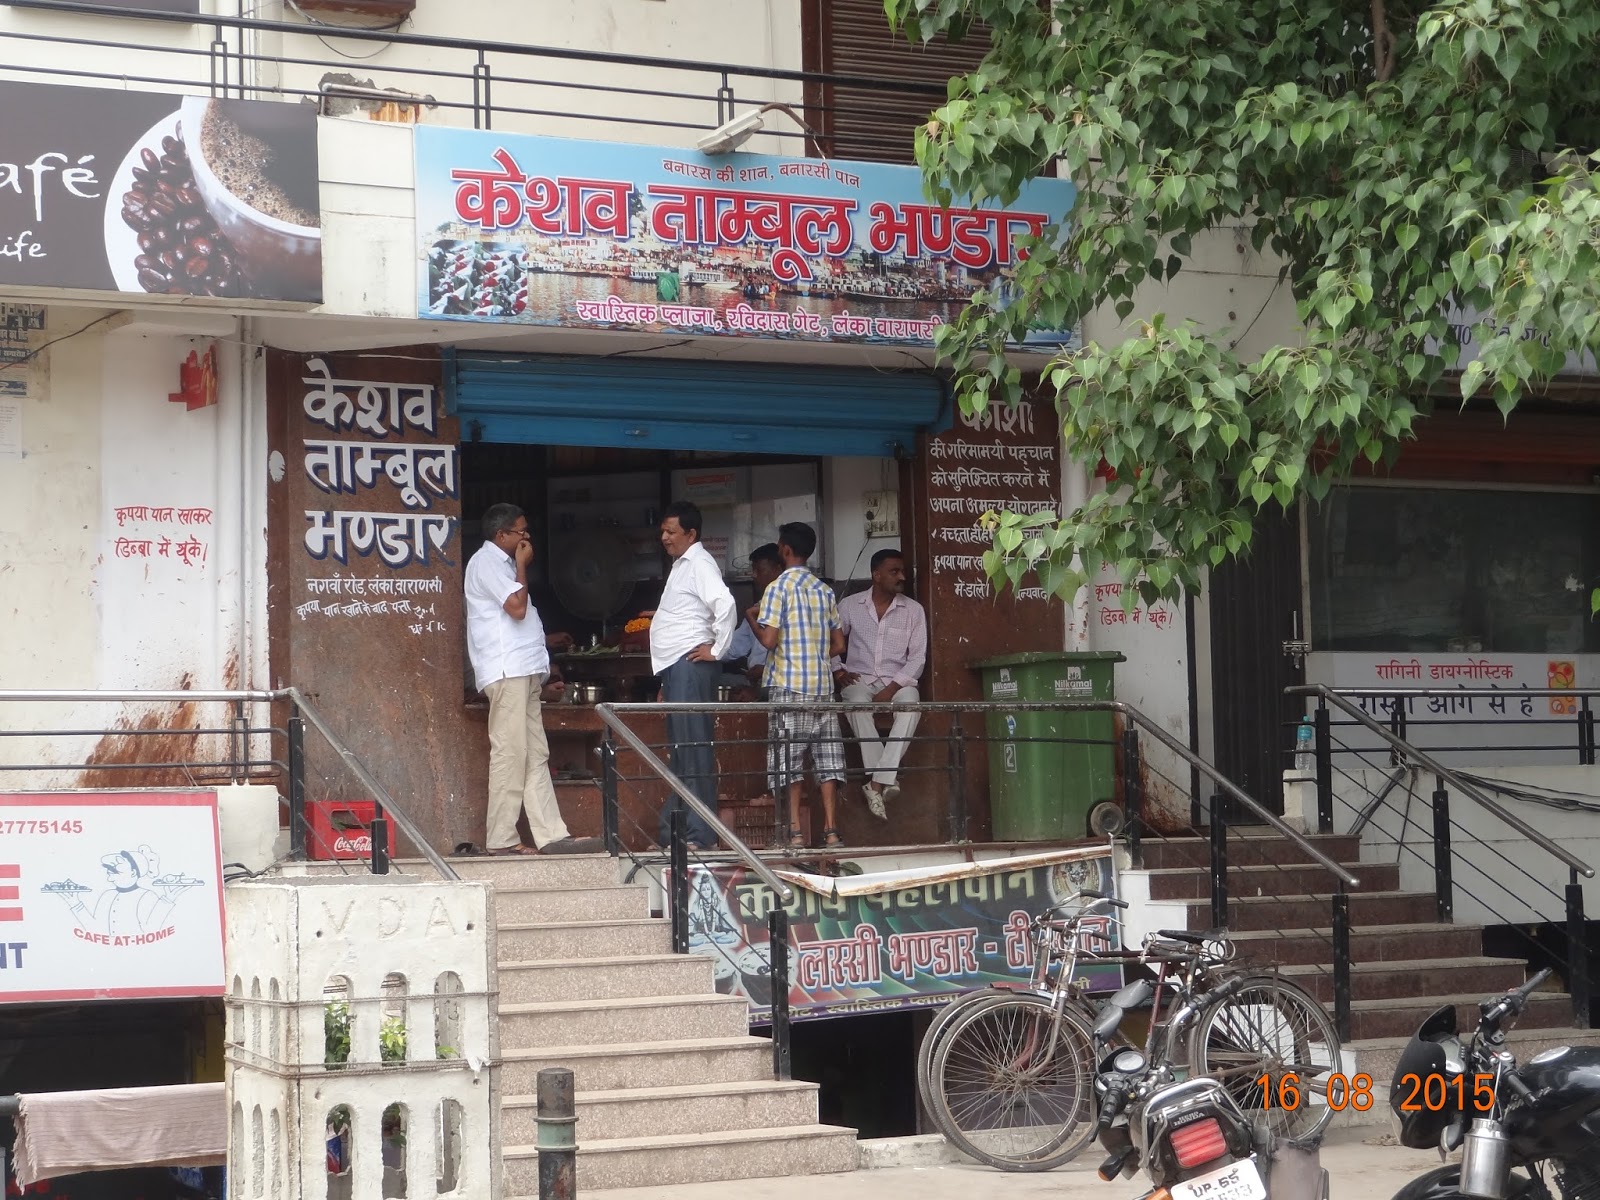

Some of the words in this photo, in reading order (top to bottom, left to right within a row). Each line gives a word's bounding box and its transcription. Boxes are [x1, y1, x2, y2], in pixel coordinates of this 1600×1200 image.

[662, 159, 711, 181] बनारस
[716, 165, 734, 182] की
[740, 166, 774, 181] शान,
[779, 162, 830, 180] बनारसी
[835, 169, 860, 188] पान
[450, 147, 634, 239] केशव
[647, 183, 857, 281] ताम्बूल
[868, 201, 1049, 269] भण्डार
[576, 295, 656, 323] स्वास्तिक
[660, 303, 722, 331] प्लाजा,
[726, 302, 790, 330] रविदास
[792, 306, 829, 336] गेट,
[831, 308, 873, 337] लंका
[302, 358, 435, 435] केशव
[930, 438, 948, 459] की
[948, 438, 1005, 460] गरिमामयी
[303, 439, 458, 508] ताम्बूल
[931, 465, 948, 487] को
[948, 467, 1001, 492] सुनिश्चित
[1001, 466, 1034, 488] करने
[1037, 467, 1050, 488] में
[114, 506, 149, 527] कृपया
[150, 507, 175, 523] पान
[177, 507, 213, 525] खाकर
[930, 498, 964, 514] अपना
[114, 537, 152, 558] डिब्बा
[157, 535, 172, 557] में
[304, 510, 457, 566] भण्डार
[343, 573, 367, 596] रोड,
[395, 576, 442, 595] वाराणसी
[1095, 583, 1122, 602] कृपया
[296, 600, 321, 620] कृपया
[321, 603, 341, 618] पान
[1375, 659, 1422, 680] रागिनी
[1429, 658, 1513, 680] डायग्नोस्टिक
[1054, 679, 1092, 688] Nilkamal
[1006, 746, 1014, 767] 2
[73, 927, 110, 946] CAFE
[114, 925, 176, 946] AT-HOME
[798, 923, 883, 990] लस्सी
[888, 926, 979, 982] भण्डार
